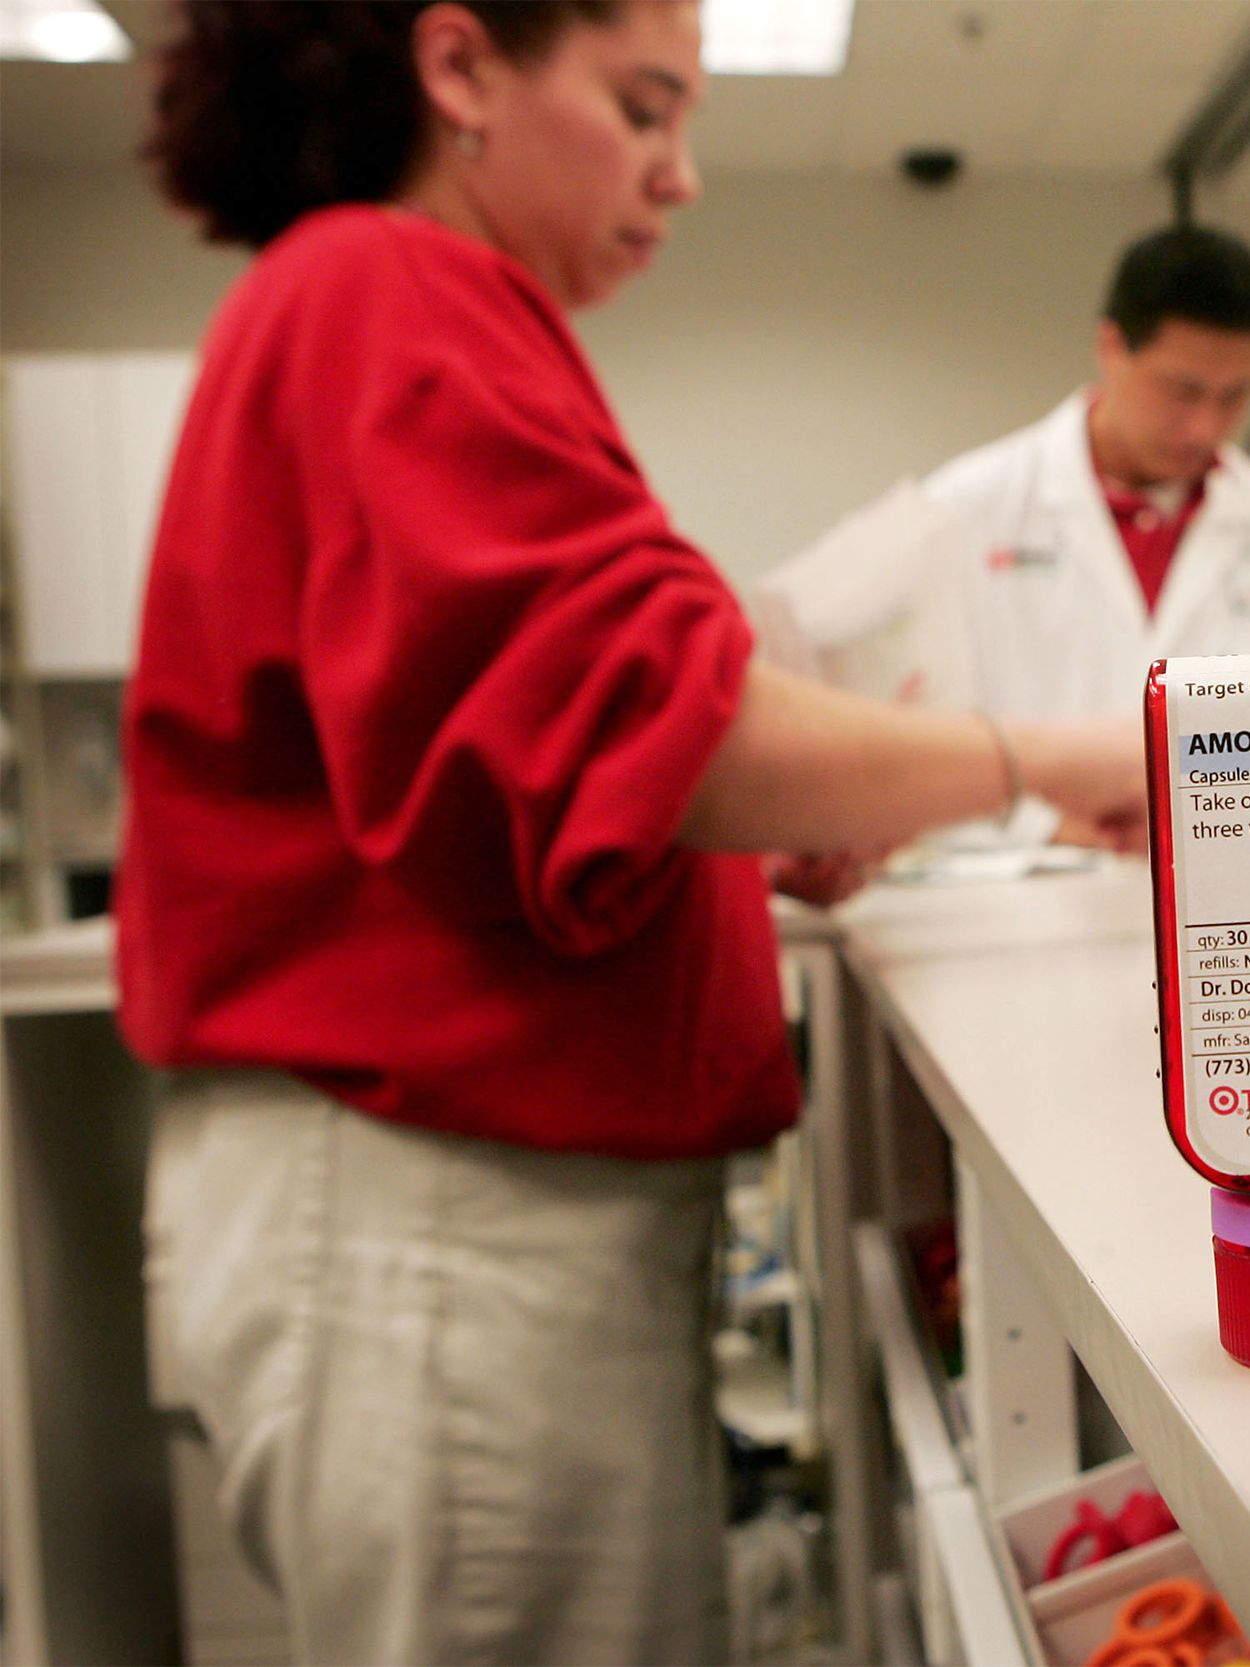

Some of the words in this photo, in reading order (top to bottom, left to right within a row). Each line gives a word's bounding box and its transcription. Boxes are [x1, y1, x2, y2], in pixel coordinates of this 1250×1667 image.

[1185, 681, 1244, 698] Target
[1189, 768, 1250, 785] Capsule
[1191, 793, 1235, 811] Take
[1193, 820, 1243, 839] three
[1197, 933, 1225, 950] qty:
[1226, 931, 1248, 946] 30
[1199, 956, 1239, 969] refills:
[1201, 981, 1227, 996] Dr.
[1202, 1009, 1235, 1023] disp:
[1203, 1034, 1230, 1047] mfr:
